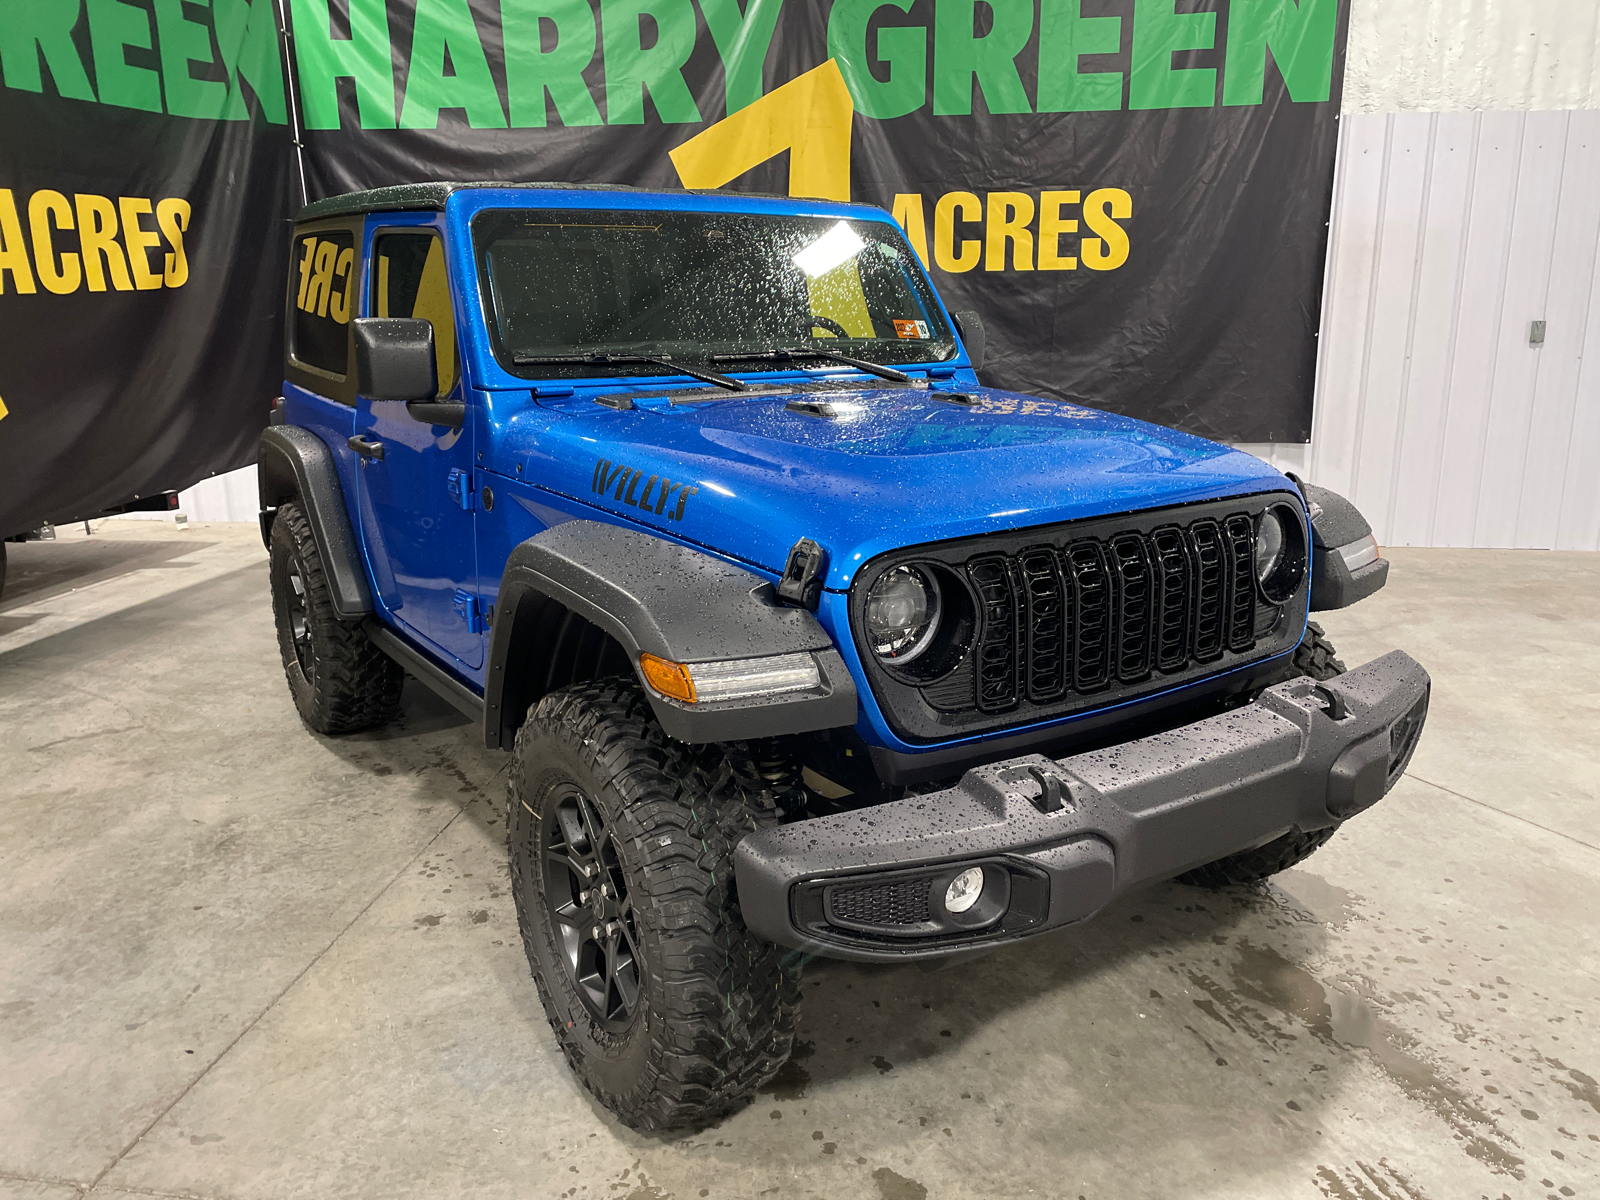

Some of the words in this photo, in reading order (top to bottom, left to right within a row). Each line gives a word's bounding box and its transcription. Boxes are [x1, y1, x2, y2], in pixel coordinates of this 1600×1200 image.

[290, 0, 783, 130] HARRY
[827, 0, 1338, 119] GREEN
[591, 458, 699, 521] WILLYS
